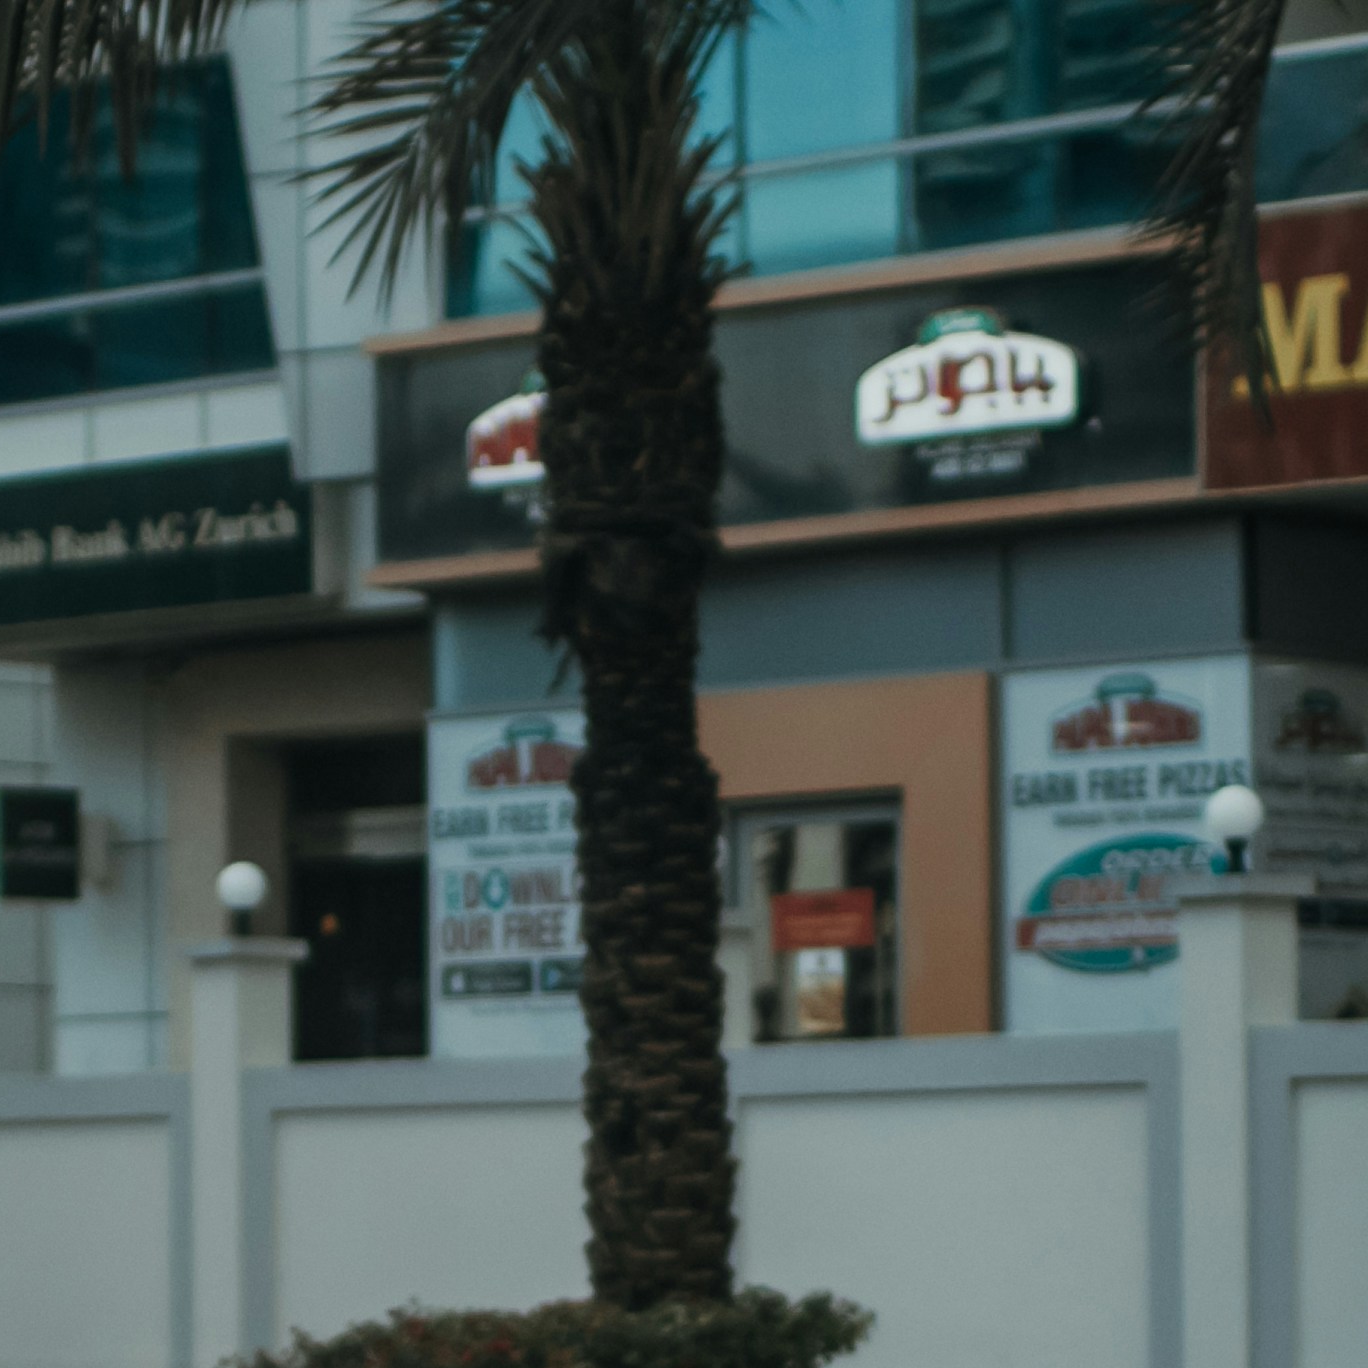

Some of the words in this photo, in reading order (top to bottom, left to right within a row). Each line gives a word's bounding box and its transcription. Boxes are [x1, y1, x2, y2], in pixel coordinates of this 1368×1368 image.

[51, 520, 127, 564] Bank
[137, 511, 185, 553] AG
[194, 499, 298, 547] Zurich
[1088, 765, 1147, 800] FREE
[1159, 758, 1249, 797] PIZZAS
[442, 915, 492, 952] OUR
[503, 911, 564, 949] FREE
